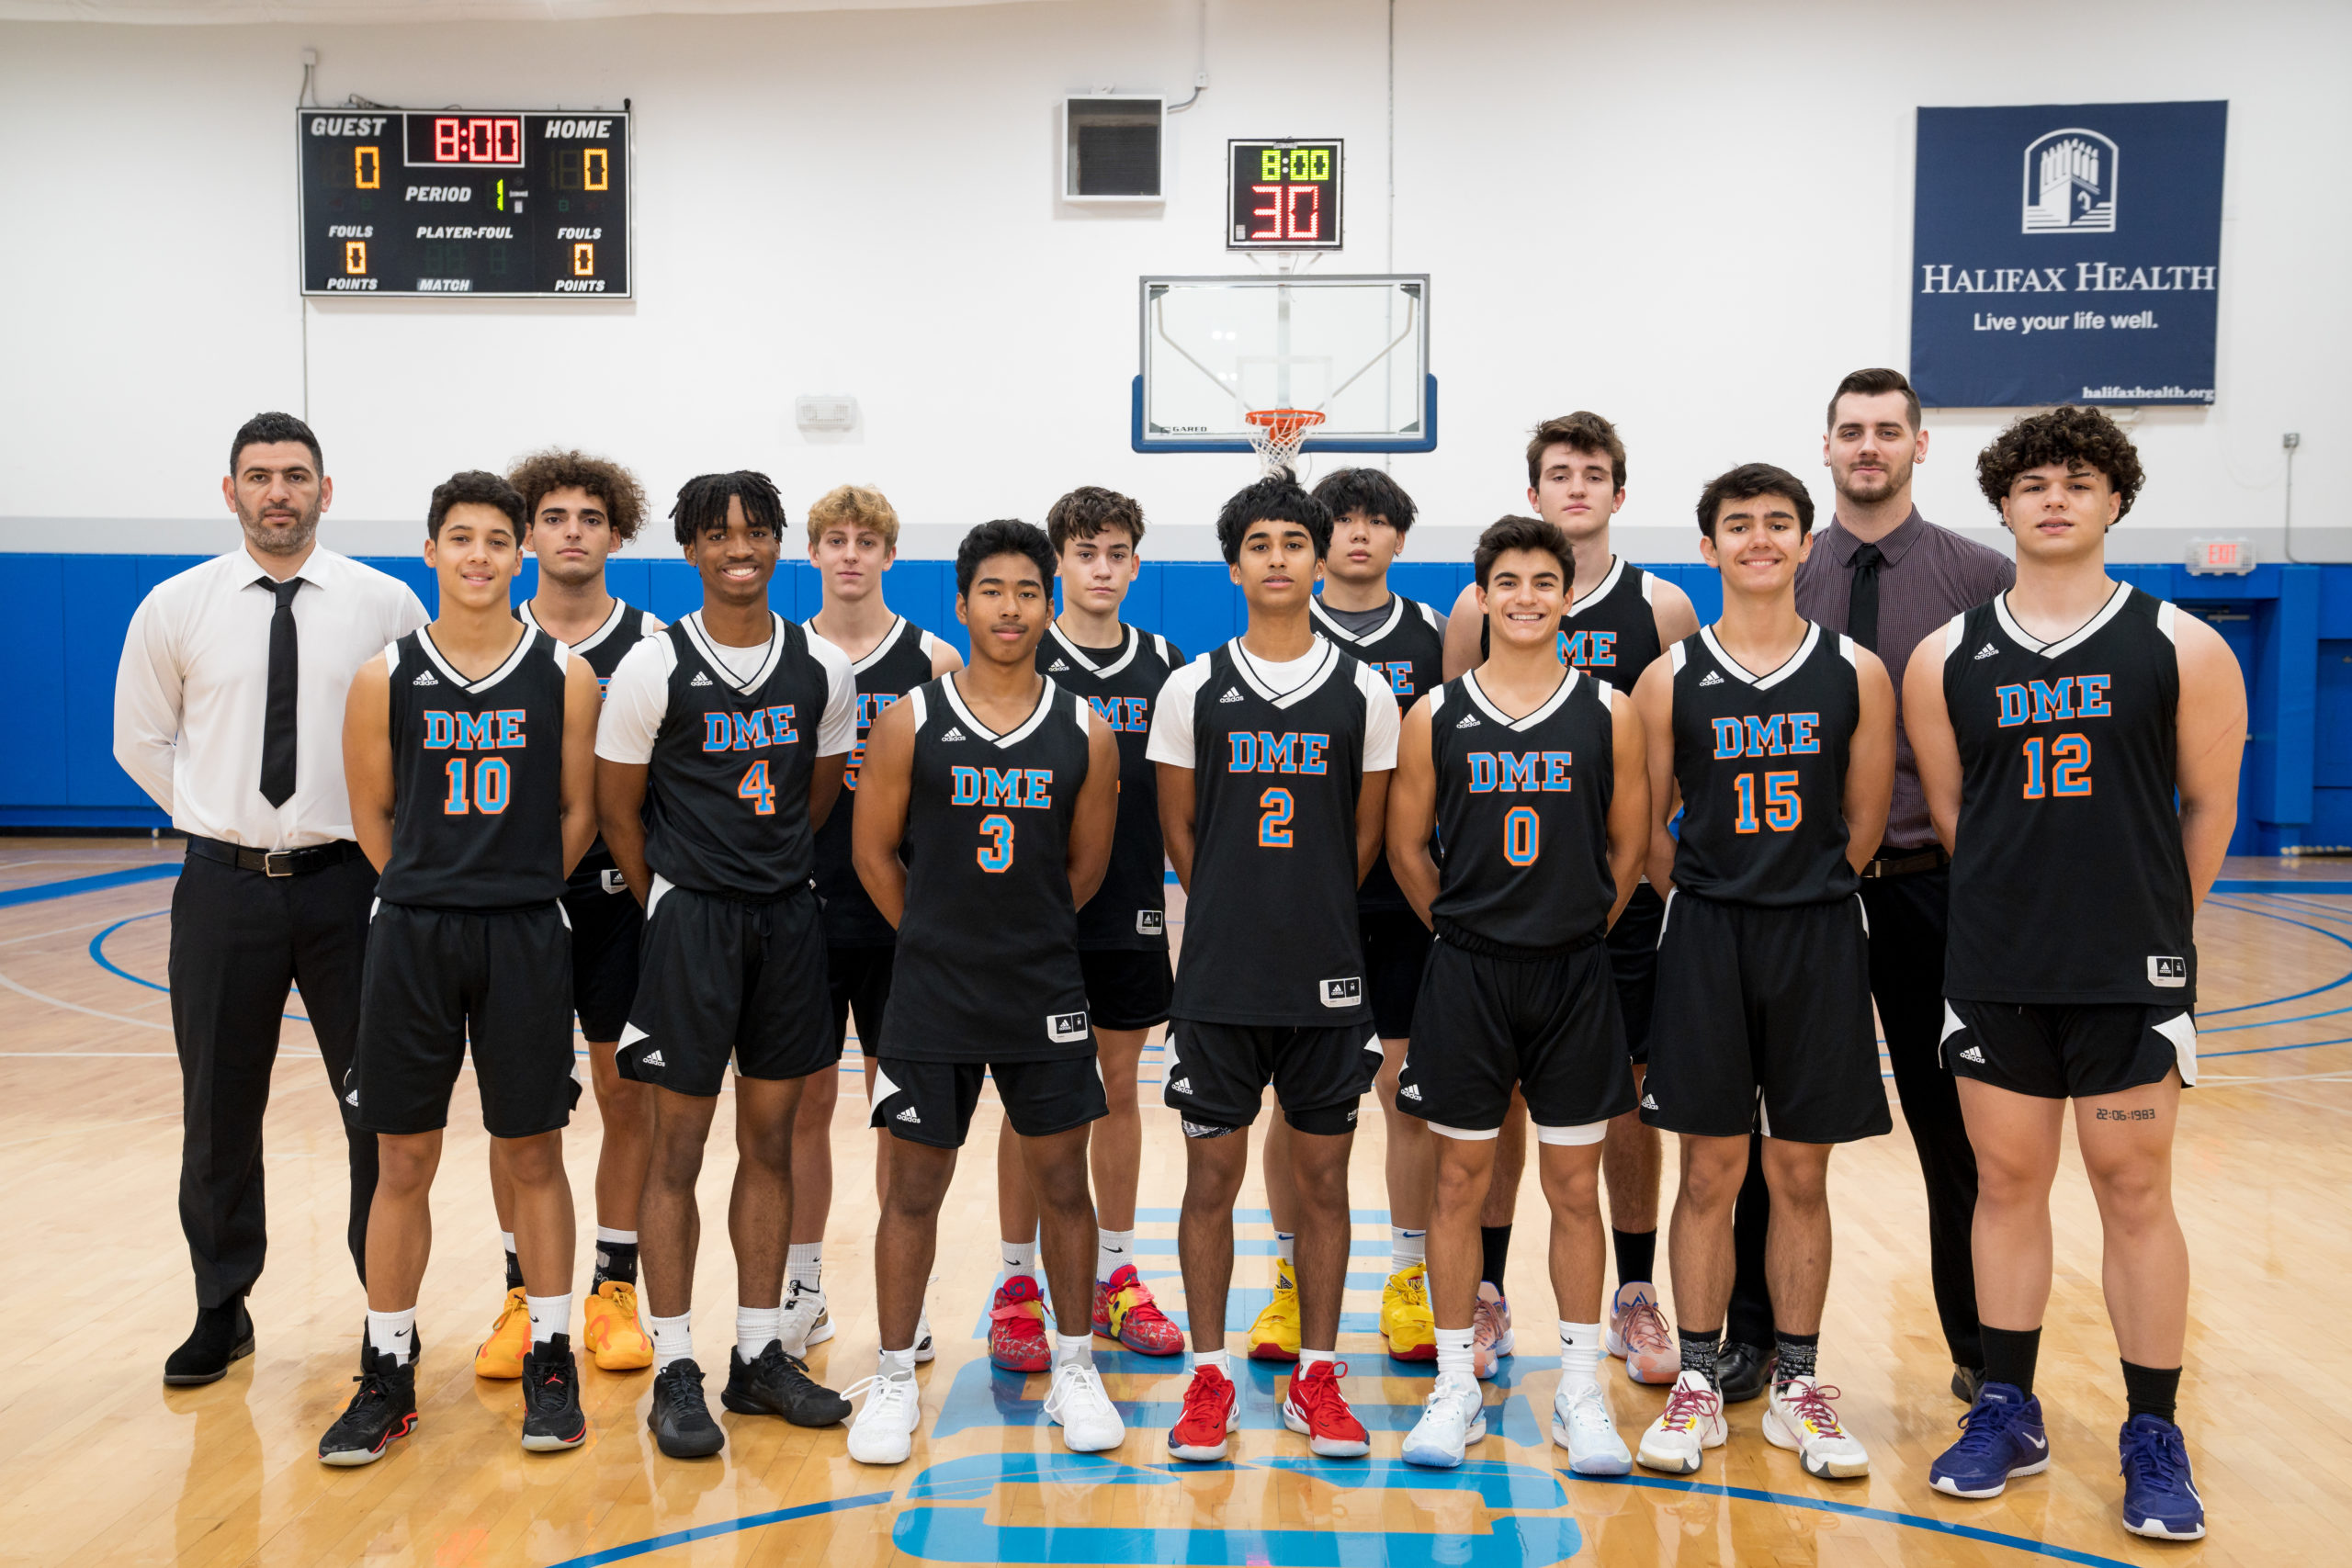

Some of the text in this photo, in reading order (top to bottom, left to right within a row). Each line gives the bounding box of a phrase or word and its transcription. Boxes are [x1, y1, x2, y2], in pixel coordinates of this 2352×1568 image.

[311, 118, 387, 136] GUEST
[435, 118, 519, 162] 8:00
[545, 119, 612, 138] HOME
[355, 146, 380, 189] 0
[583, 148, 608, 190] 0
[1261, 150, 1329, 181] 8:00
[405, 186, 471, 202] PERIOD
[496, 178, 503, 211] 1
[1251, 186, 1318, 239] 30
[328, 225, 373, 238] FOULS
[416, 227, 514, 240] PLAYER-FOUL
[557, 228, 602, 240] FOULS
[346, 241, 367, 274] 0
[574, 243, 594, 276] 0
[327, 278, 378, 291] POINTS
[419, 279, 469, 291] MATCH
[555, 279, 605, 292] POINTS
[1921, 262, 2216, 293] HALIFAX HEALTH
[1974, 310, 2159, 334] Live your life well.
[2082, 386, 2214, 401] halifaxhealth.org
[2209, 544, 2237, 564] EXIT
[1556, 630, 1617, 667] ME
[1088, 696, 1148, 732] ME
[1996, 673, 2111, 728] DME
[424, 709, 526, 750] DME
[703, 705, 799, 752] DME
[1711, 712, 1820, 760] DME
[1228, 731, 1329, 775] DME
[2022, 733, 2092, 799] 12
[445, 756, 511, 815] 10
[738, 760, 775, 816] 4
[951, 765, 1053, 809] DME
[1467, 751, 1572, 793] DME
[1259, 787, 1294, 848] 2
[1734, 770, 1803, 834] 15
[977, 814, 1014, 873] 3
[1504, 806, 1540, 866] 0
[1960, 1052, 1985, 1064] adidas
[1171, 1084, 1193, 1095] adidas
[897, 1113, 921, 1123] adidas
